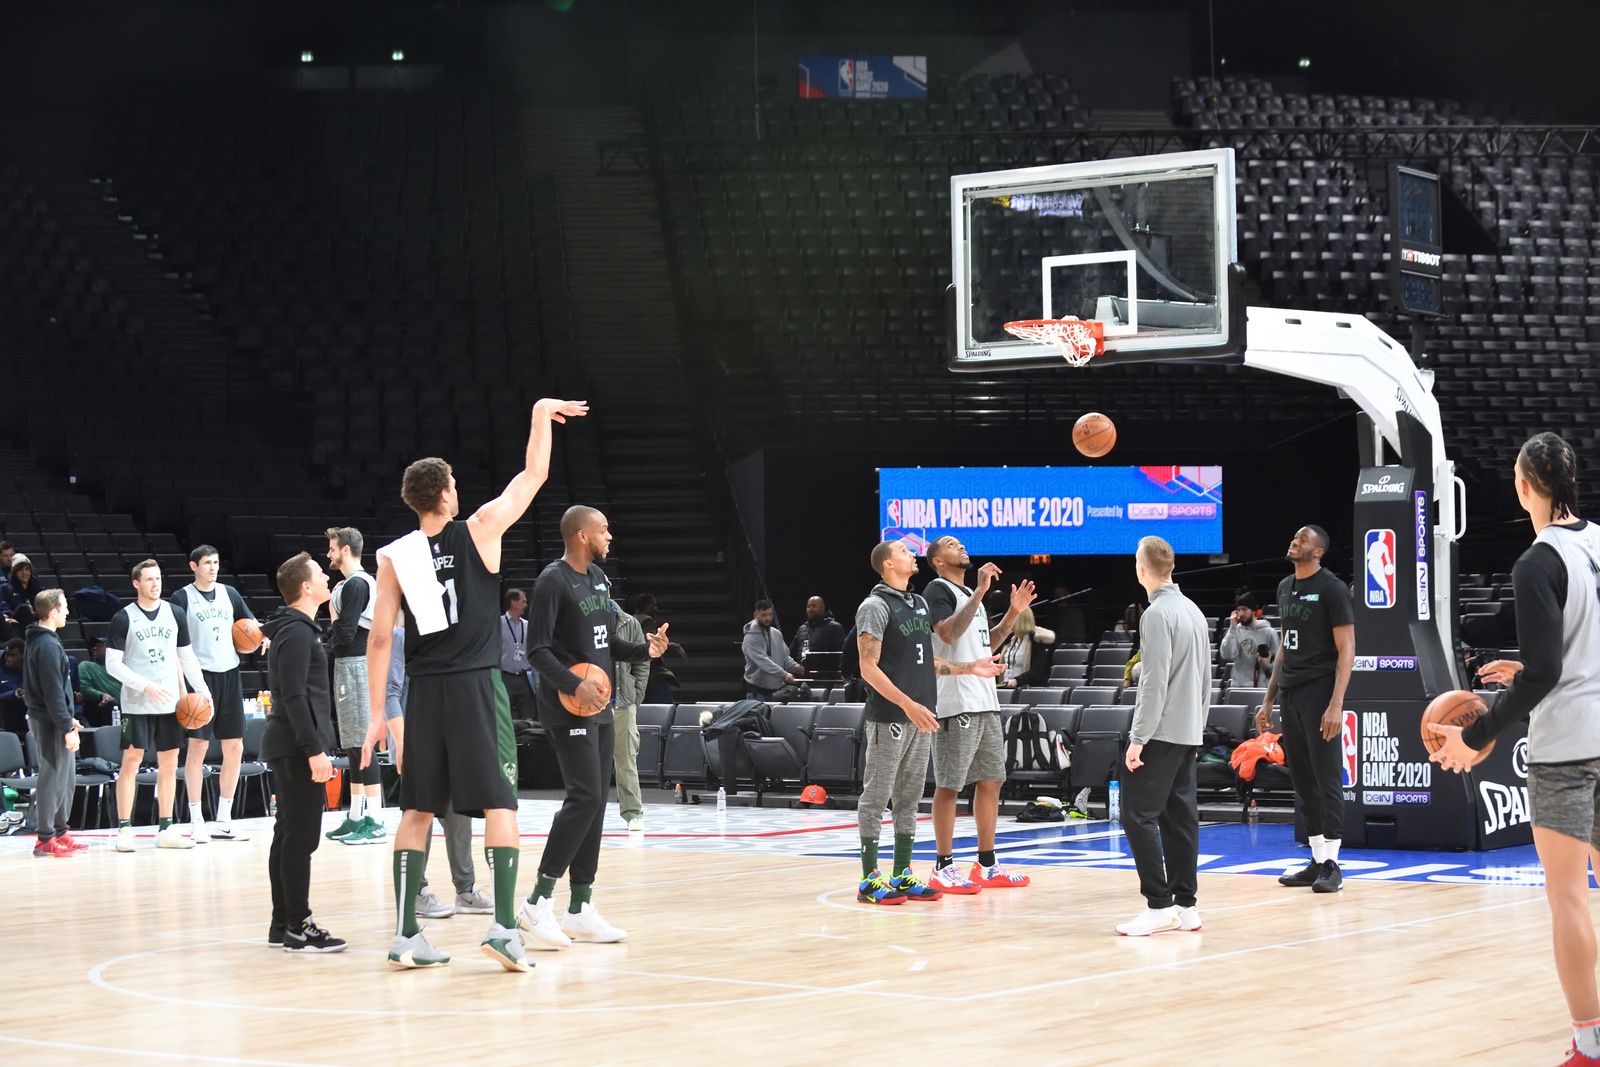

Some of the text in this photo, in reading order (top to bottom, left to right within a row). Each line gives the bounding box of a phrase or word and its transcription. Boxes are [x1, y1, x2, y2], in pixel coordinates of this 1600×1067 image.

[1413, 250, 1441, 266] TISSOT
[965, 350, 992, 358] SPALDING
[1361, 482, 1405, 495] SPALDING
[902, 498, 937, 528] NBA
[940, 498, 989, 528] PARIS
[992, 497, 1036, 527] GAME
[1039, 496, 1084, 527] 2020
[1087, 505, 1115, 518] Presented
[1115, 506, 1124, 519] by
[1170, 506, 1213, 516] SPORTS
[1417, 496, 1426, 557] SPORTS
[433, 555, 455, 571] OPEZ
[578, 594, 610, 617] BUCKS
[1369, 590, 1385, 603] NBA
[196, 608, 230, 623] BUCKS
[135, 626, 172, 642] BUCKS
[212, 627, 220, 642] 7
[593, 625, 609, 649] 22
[899, 617, 931, 637] BUCKS
[1283, 629, 1299, 650] 43
[915, 643, 925, 665] 3
[1379, 659, 1414, 669] SPORTS
[1362, 712, 1388, 737] NBA
[1362, 737, 1399, 762] PARIS
[1362, 762, 1431, 788] GAME 2020
[1395, 794, 1428, 803] SPORTS
[1479, 781, 1531, 835] SPAL
